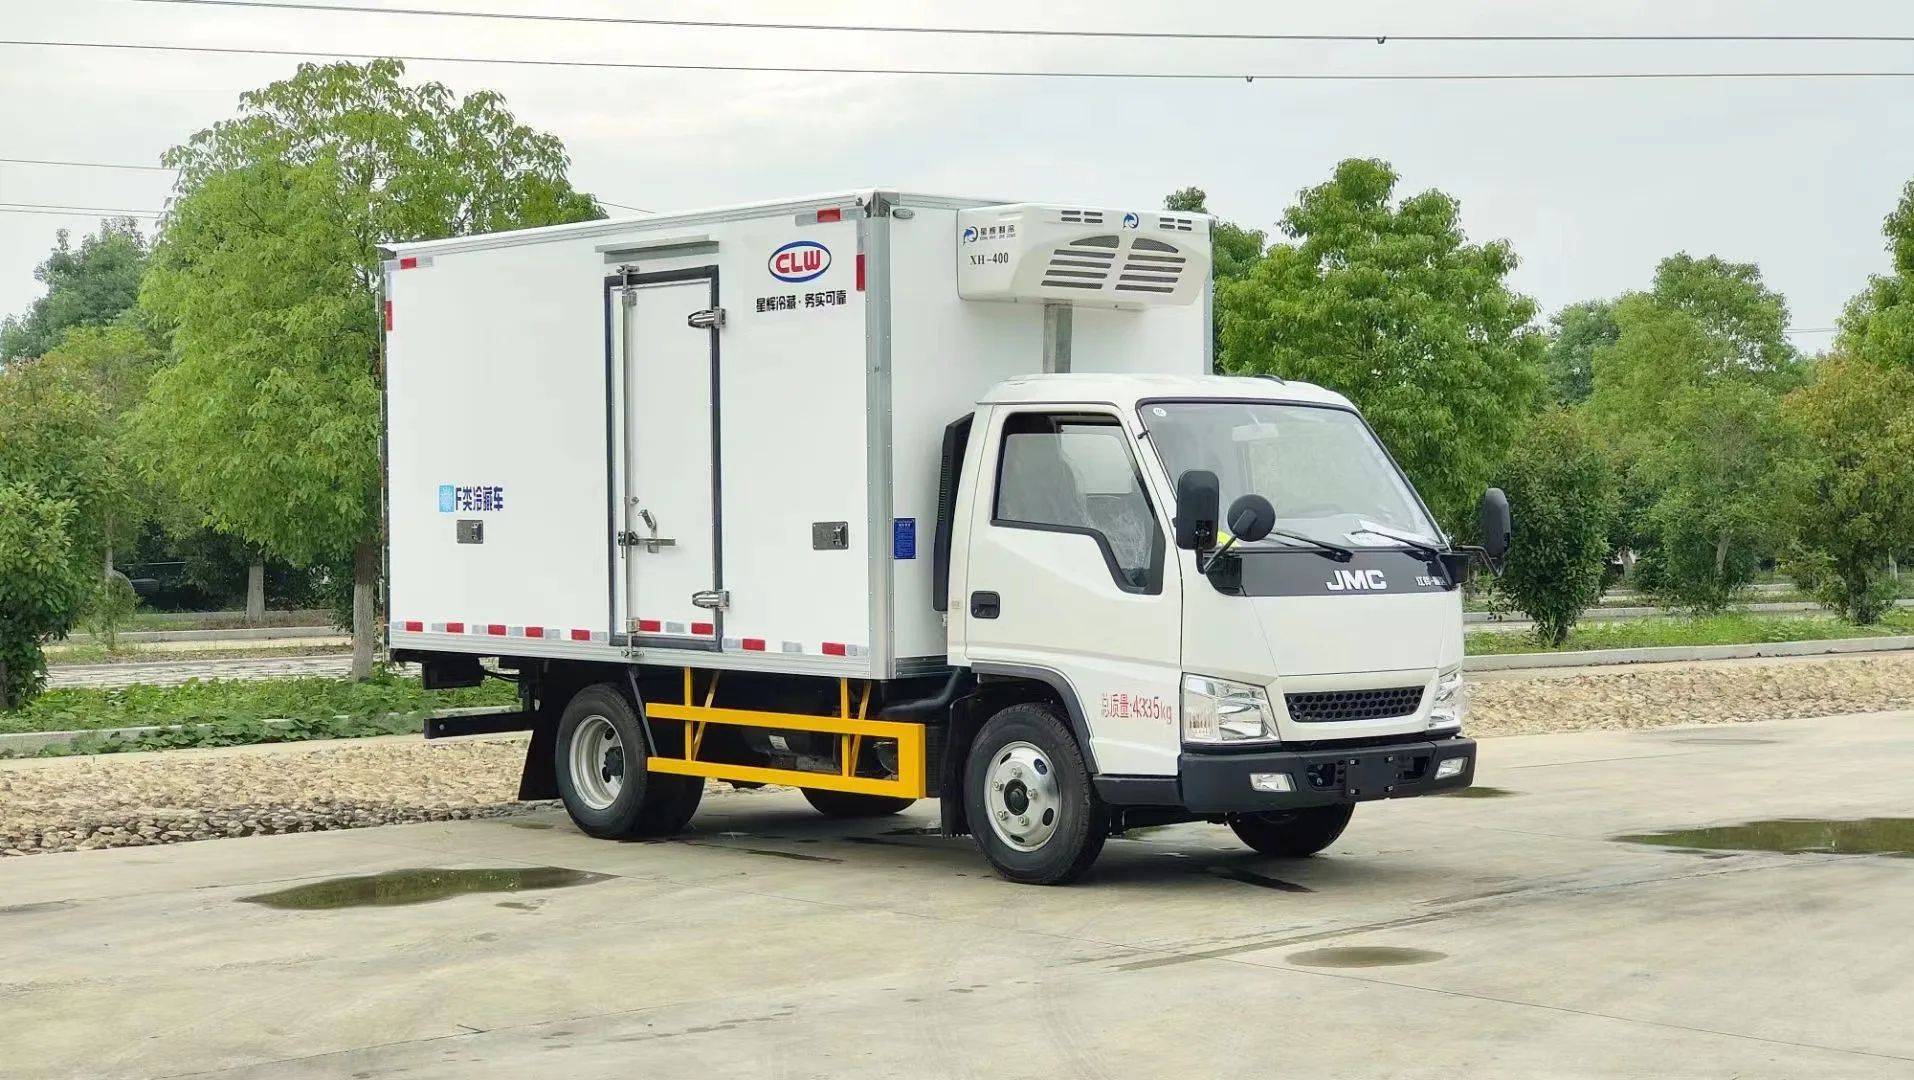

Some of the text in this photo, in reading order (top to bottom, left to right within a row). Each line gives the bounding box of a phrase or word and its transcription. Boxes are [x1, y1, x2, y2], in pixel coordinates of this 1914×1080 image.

[776, 250, 820, 274] CLW
[970, 252, 1009, 265] XH-400
[455, 486, 504, 511] F类冷藏车
[1325, 569, 1387, 591] JMC
